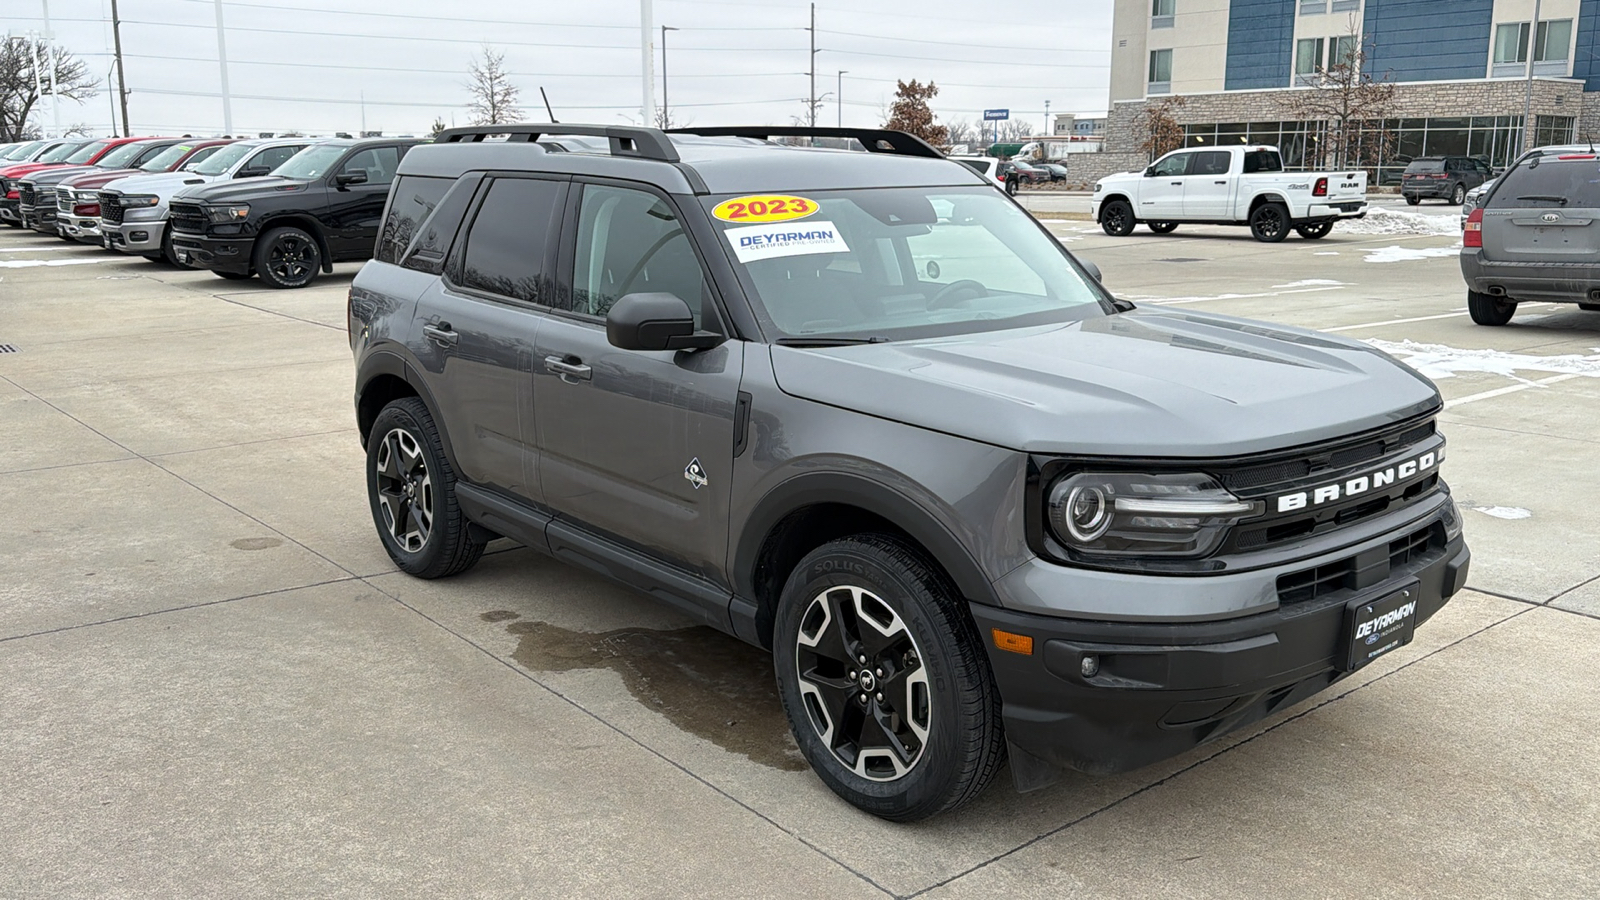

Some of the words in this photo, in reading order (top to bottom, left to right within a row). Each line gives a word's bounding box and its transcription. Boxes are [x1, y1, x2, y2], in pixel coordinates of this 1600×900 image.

[727, 198, 810, 219] 2023
[740, 230, 833, 247] DEYARMAN
[750, 242, 790, 250] CERTIFIED
[1277, 452, 1435, 513] BRONCO
[814, 560, 864, 574] SOLUS
[1355, 600, 1417, 640] DEYARMAN
[1380, 622, 1405, 638] INDIANOLA
[912, 616, 946, 692] KUMHO
